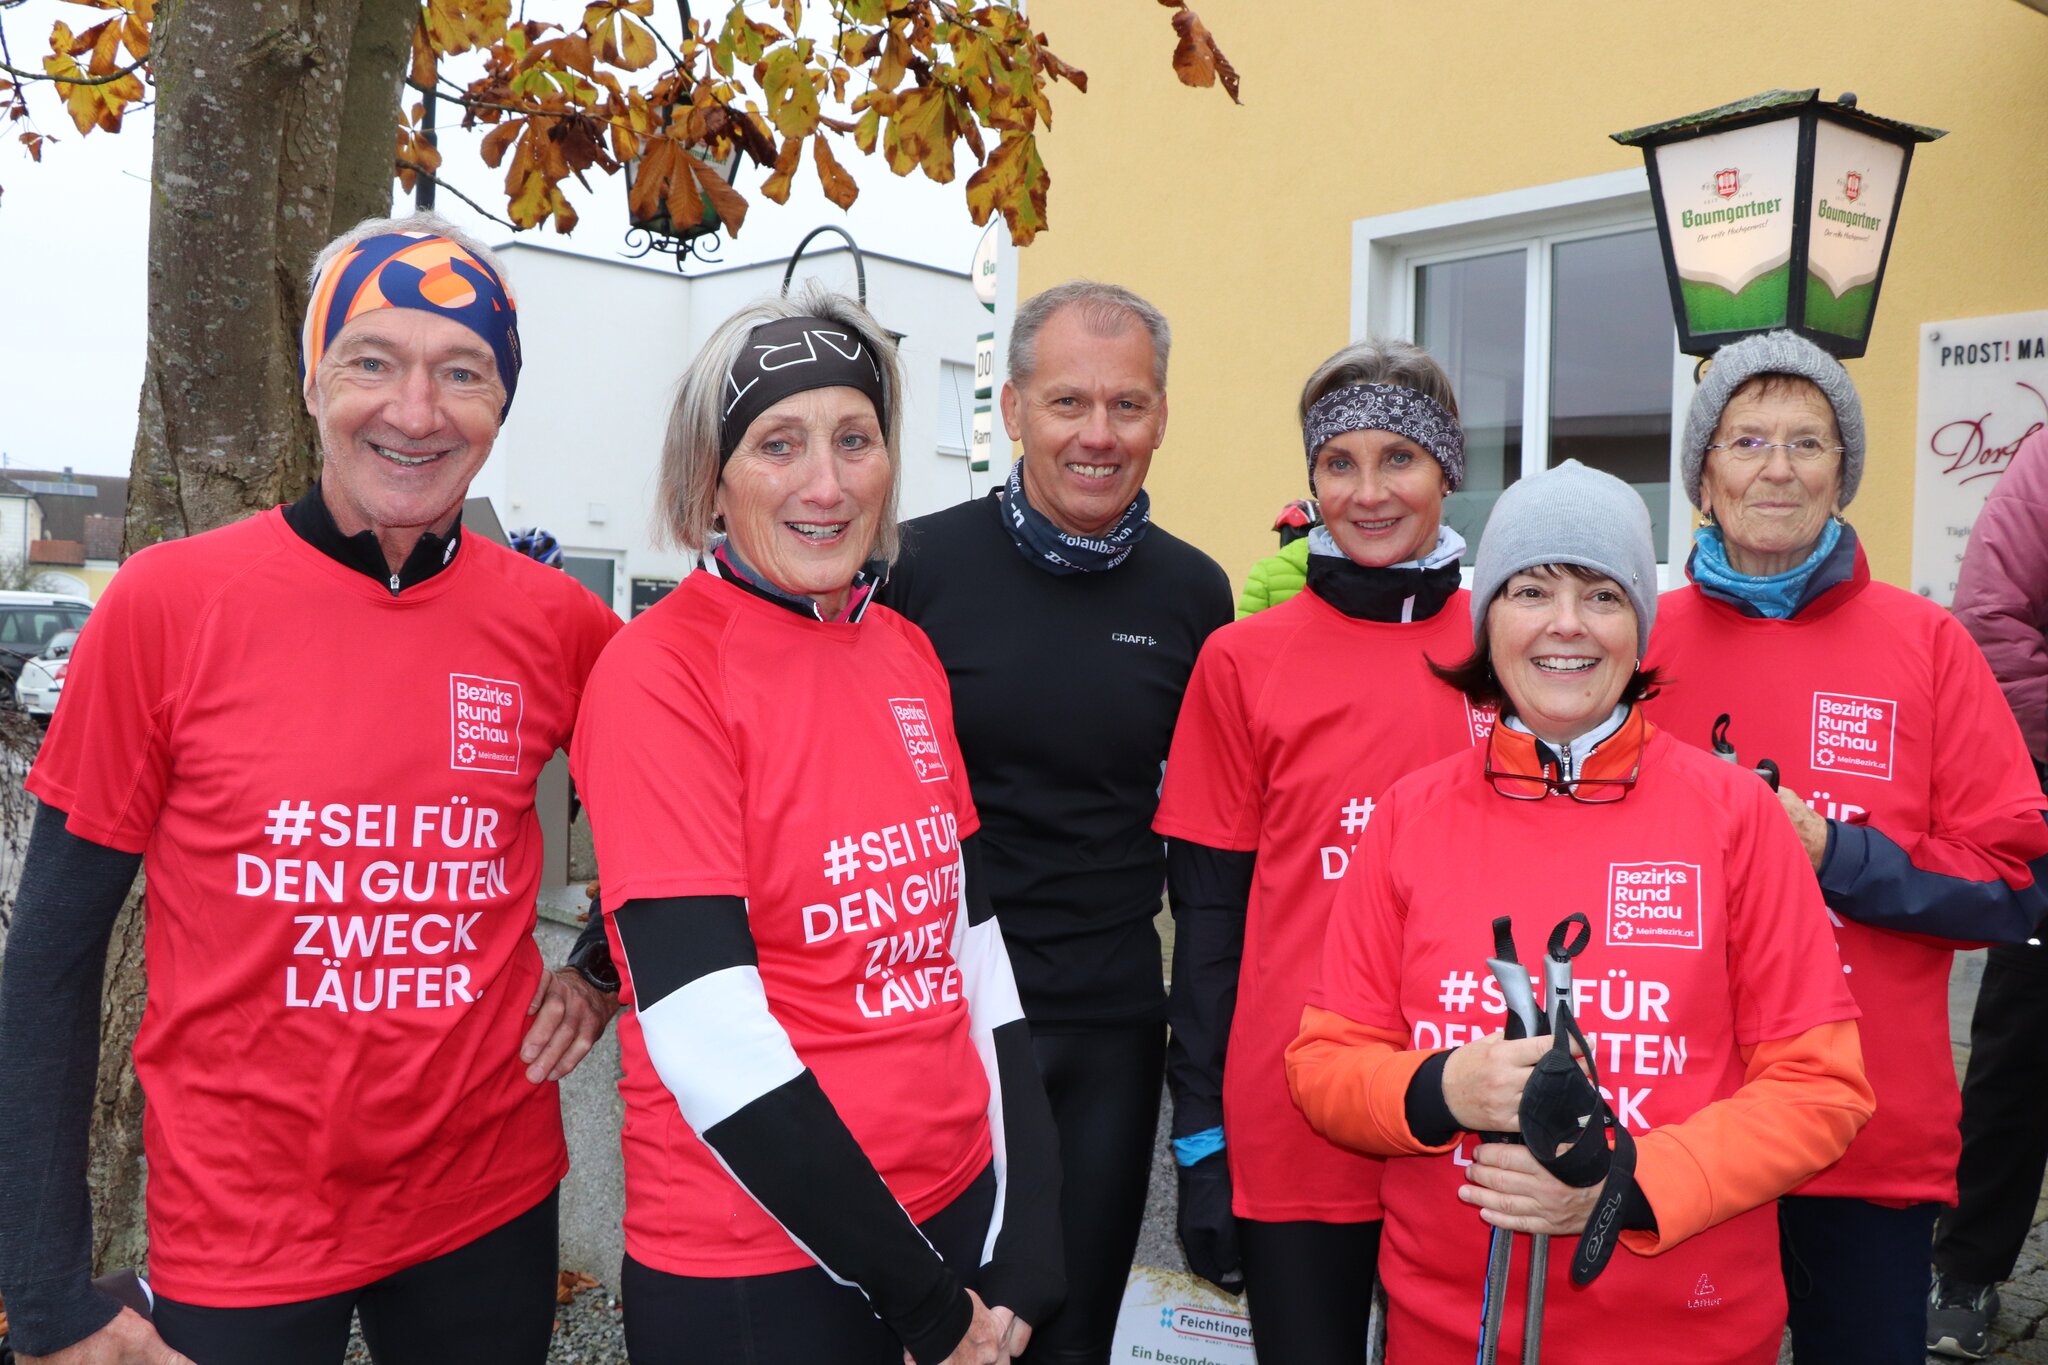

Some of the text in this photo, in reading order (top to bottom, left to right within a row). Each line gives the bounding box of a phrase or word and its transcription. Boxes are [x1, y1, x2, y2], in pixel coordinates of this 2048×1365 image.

[1681, 197, 1782, 229] Baumgartner
[1818, 199, 1882, 231] Baumgartner
[978, 350, 995, 378] DO
[1940, 340, 2010, 367] PROST!
[974, 429, 991, 445] Ram
[1931, 412, 2044, 474] Dorf
[1111, 632, 1148, 645] CRAFT
[456, 682, 513, 706] Bezirks
[457, 702, 501, 723] Rund
[1819, 699, 1883, 720] Bezirks
[458, 721, 508, 743] Schau
[902, 721, 929, 737] Rund
[1474, 723, 1492, 737] Sc
[1818, 714, 1868, 734] Rund
[908, 738, 938, 755] Schau
[1818, 730, 1877, 752] Schau
[478, 751, 516, 762] MeinBezirk.at
[1837, 755, 1887, 769] MeinBezirk.at
[264, 795, 499, 848] #SEI FÜR
[823, 805, 959, 885] #SEI FÜR
[1320, 845, 1357, 880] D
[236, 853, 510, 902] DEN GUTEN
[1615, 867, 1688, 885] Bezirks
[802, 860, 959, 944] DEN GUTE
[1615, 885, 1670, 901] Rund
[1614, 902, 1682, 919] Schau
[293, 911, 484, 958] ZWECK
[1635, 927, 1695, 937] MeinBezirk.at
[285, 958, 485, 1013] LÄUFER.
[856, 965, 960, 1019] LÄUFE
[1572, 969, 1670, 1023] FÜR
[1180, 1315, 1253, 1338] Feichtinger
[1131, 1345, 1227, 1365] Ein besonde
